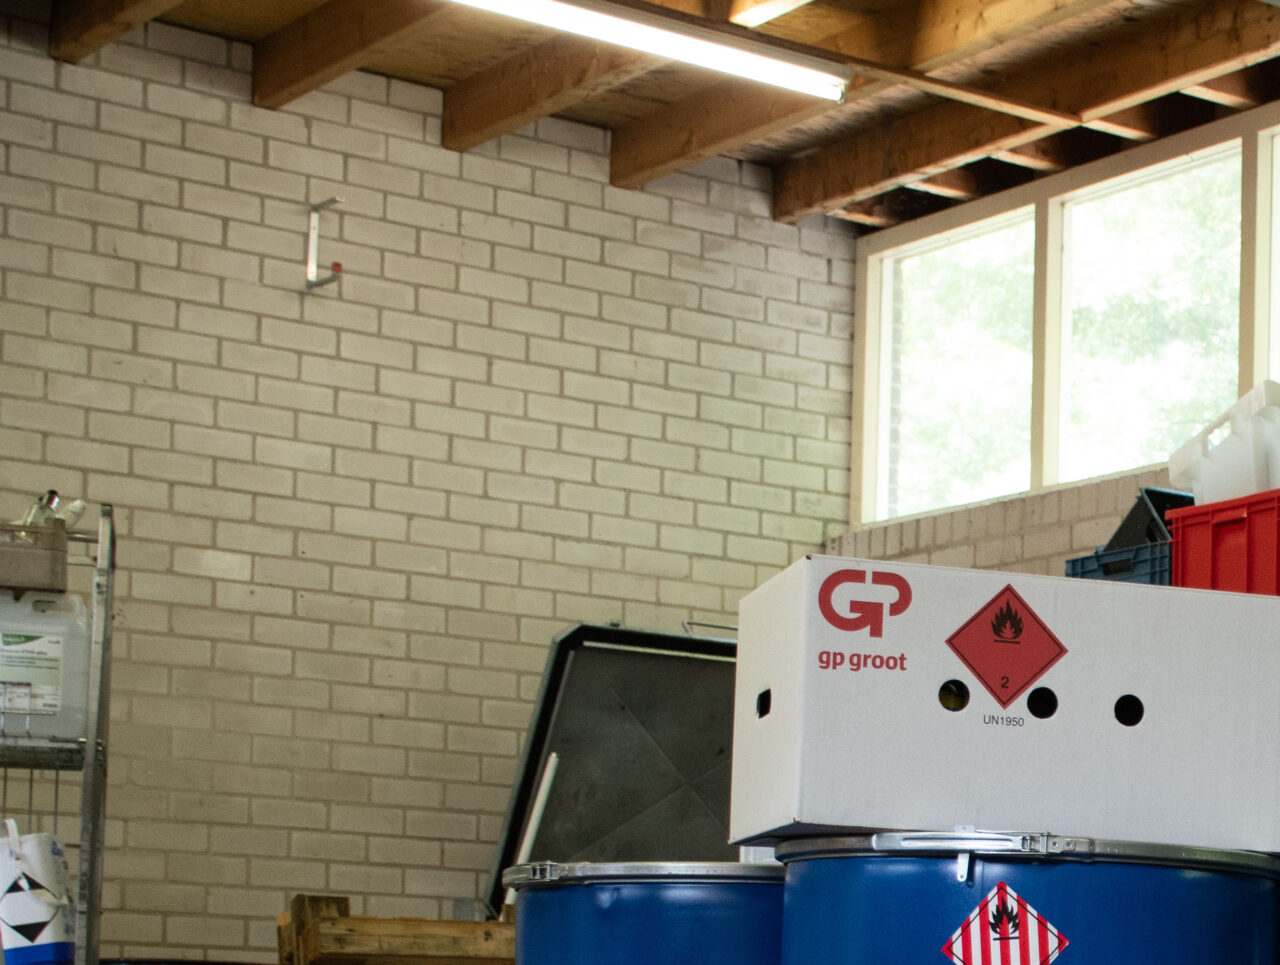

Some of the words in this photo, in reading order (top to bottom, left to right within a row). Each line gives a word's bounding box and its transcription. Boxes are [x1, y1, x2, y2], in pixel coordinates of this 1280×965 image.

[818, 650, 845, 670] gp
[849, 652, 908, 672] groot
[1001, 676, 1010, 689] 2
[983, 714, 1025, 727] UN1950
